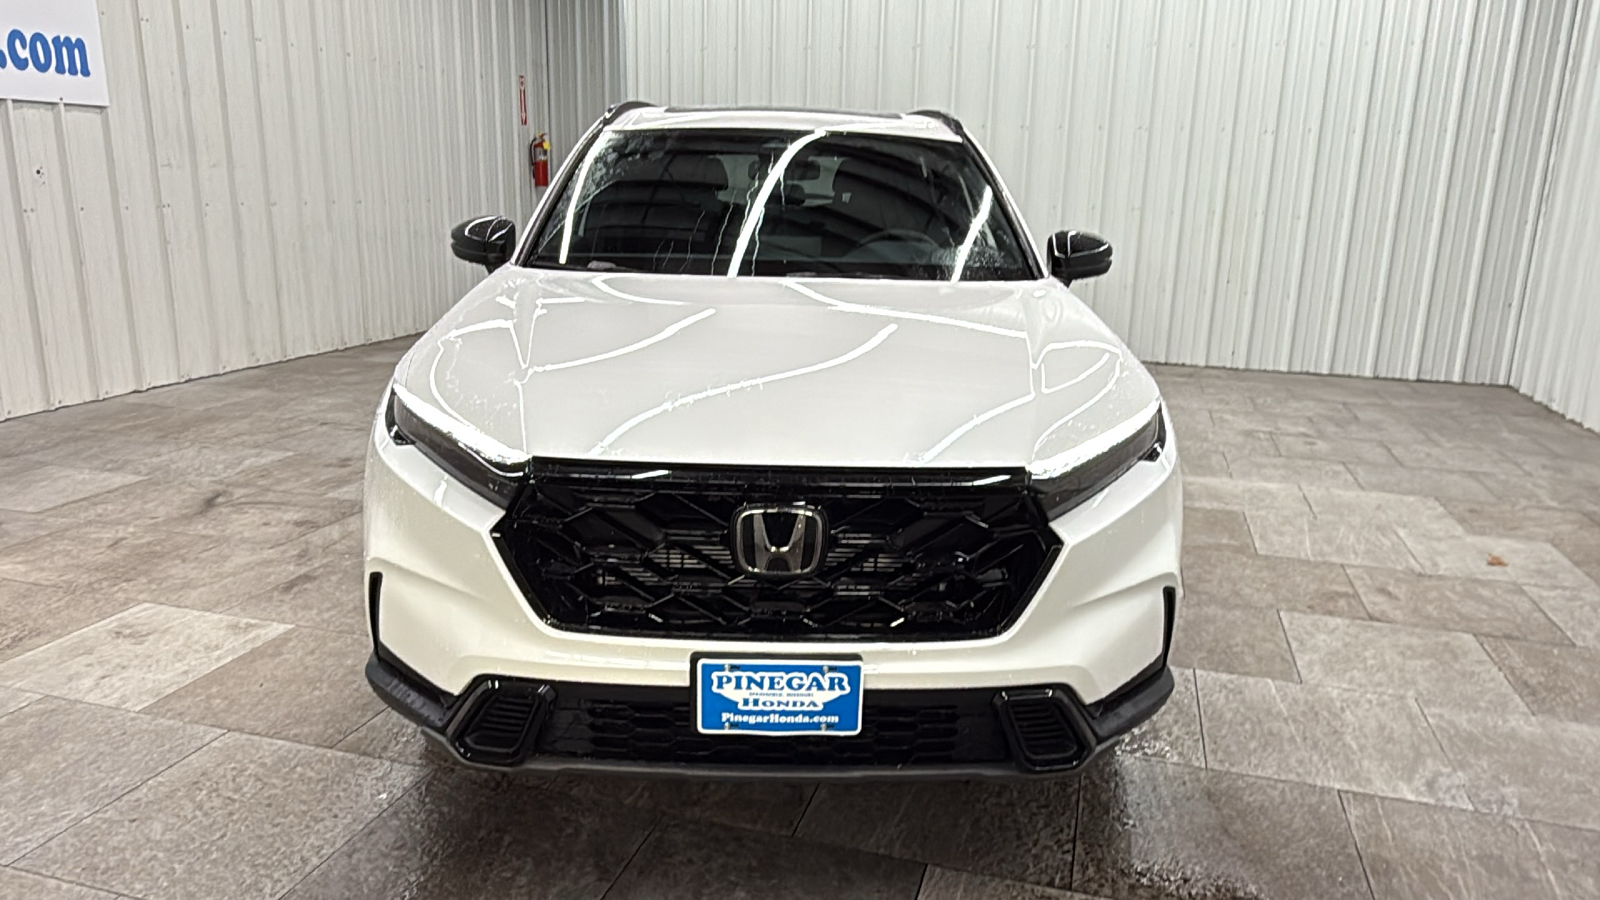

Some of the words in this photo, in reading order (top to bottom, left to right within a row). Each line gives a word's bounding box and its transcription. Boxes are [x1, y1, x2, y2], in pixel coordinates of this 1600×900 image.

[715, 675, 847, 692] PINEGAR
[742, 697, 820, 708] HONDA
[721, 712, 839, 724] PinegarHonda.com
